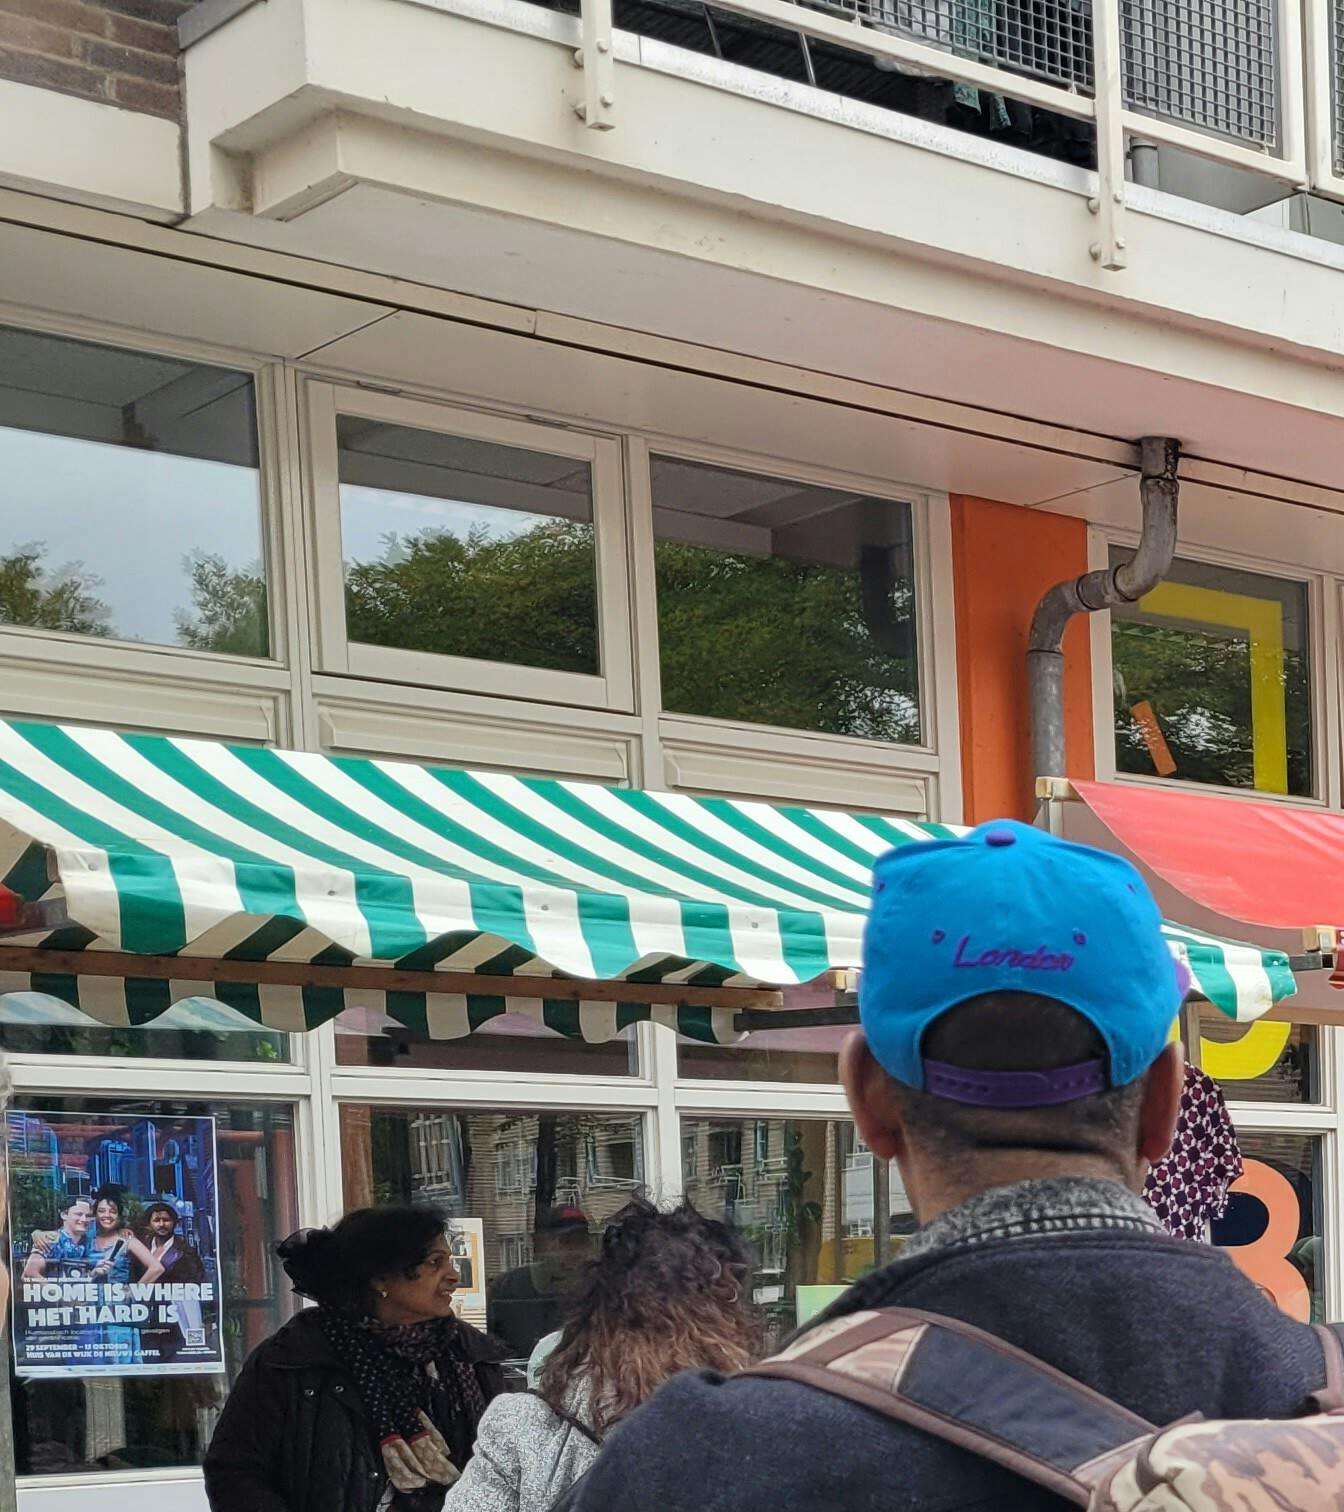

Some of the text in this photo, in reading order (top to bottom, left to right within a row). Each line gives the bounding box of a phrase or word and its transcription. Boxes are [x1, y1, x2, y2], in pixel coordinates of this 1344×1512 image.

[953, 934, 1075, 972] London
[24, 1283, 214, 1302] HOME IS WHERE
[28, 1306, 73, 1327] HET
[158, 1305, 179, 1323] IS
